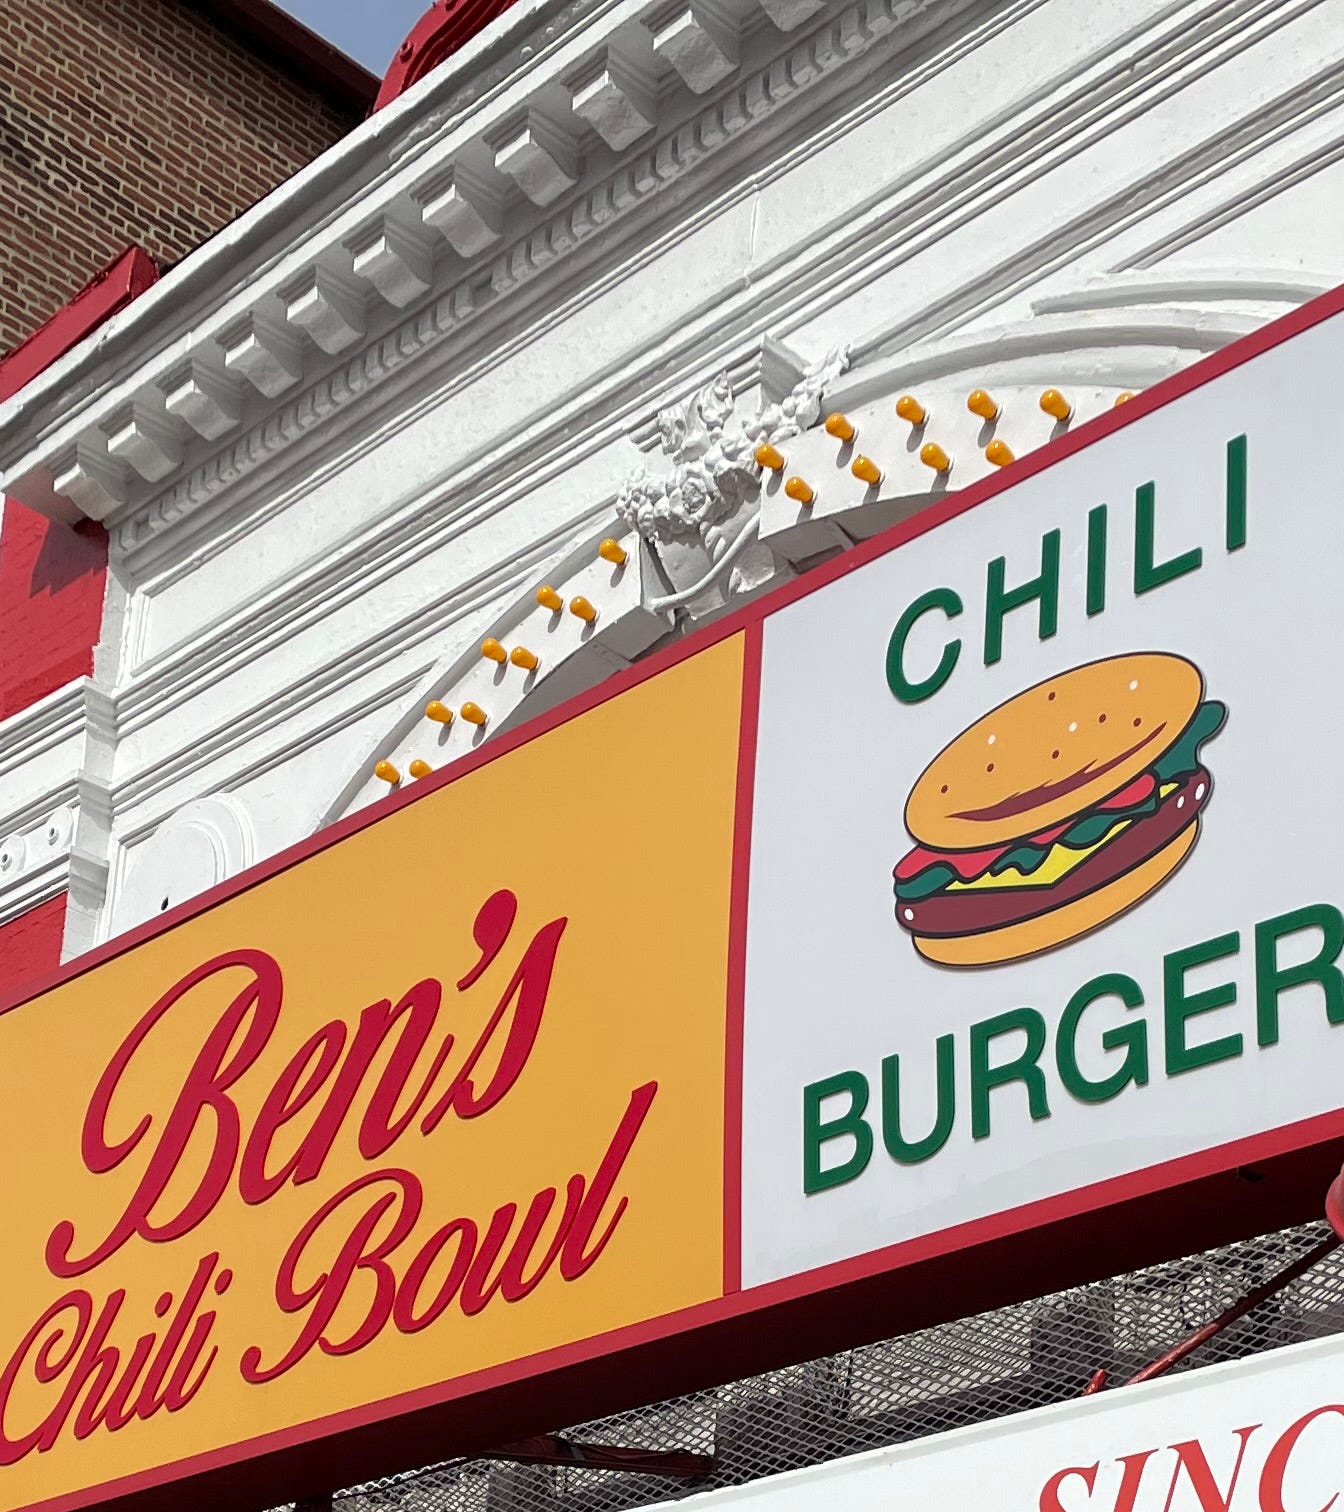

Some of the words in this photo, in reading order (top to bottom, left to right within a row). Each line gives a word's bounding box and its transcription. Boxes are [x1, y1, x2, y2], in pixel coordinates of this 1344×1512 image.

[885, 433, 1248, 705] CHILI
[45, 888, 569, 1279] Ben's
[240, 1080, 658, 1385] Bowl
